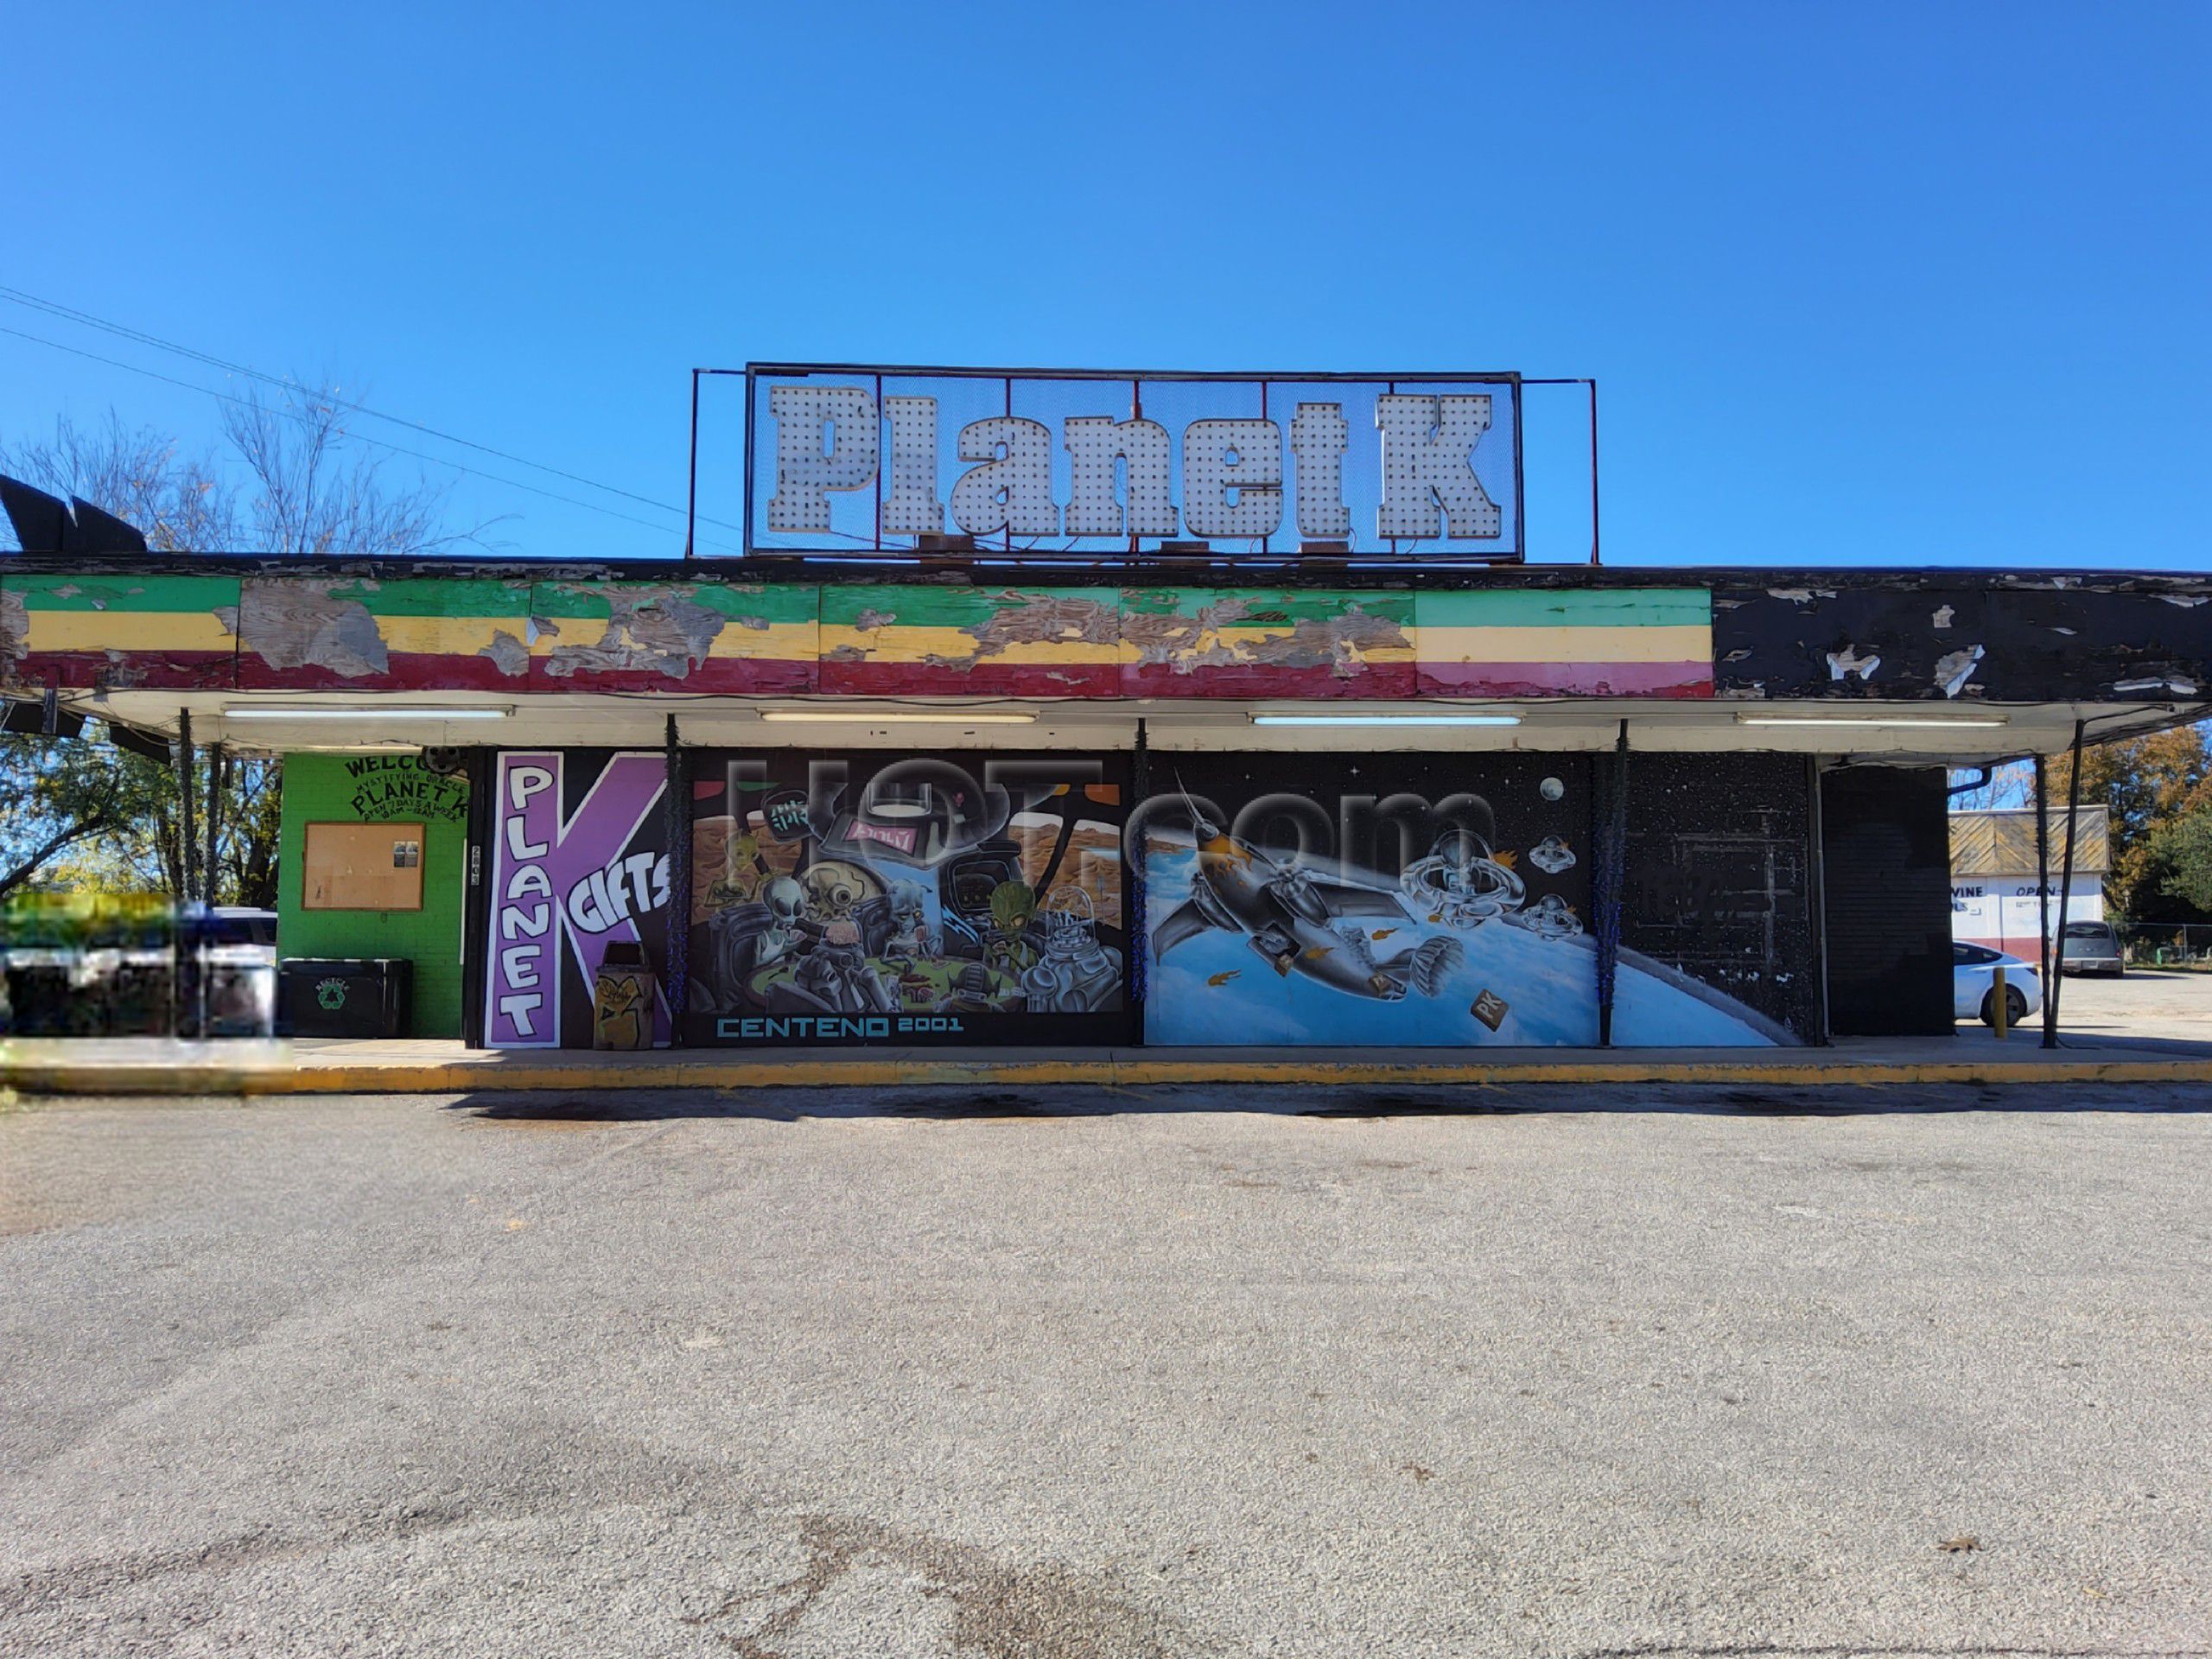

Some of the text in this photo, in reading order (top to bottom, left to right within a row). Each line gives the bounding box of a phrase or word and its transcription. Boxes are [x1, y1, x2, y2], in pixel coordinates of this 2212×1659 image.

[767, 385, 1503, 539] Planet K
[351, 781, 468, 818] PLANET K
[472, 847, 480, 884] 203
[567, 851, 672, 934] GIFTS
[500, 765, 555, 1039] PLANET
[717, 1017, 964, 1038] CENTENO 2001
